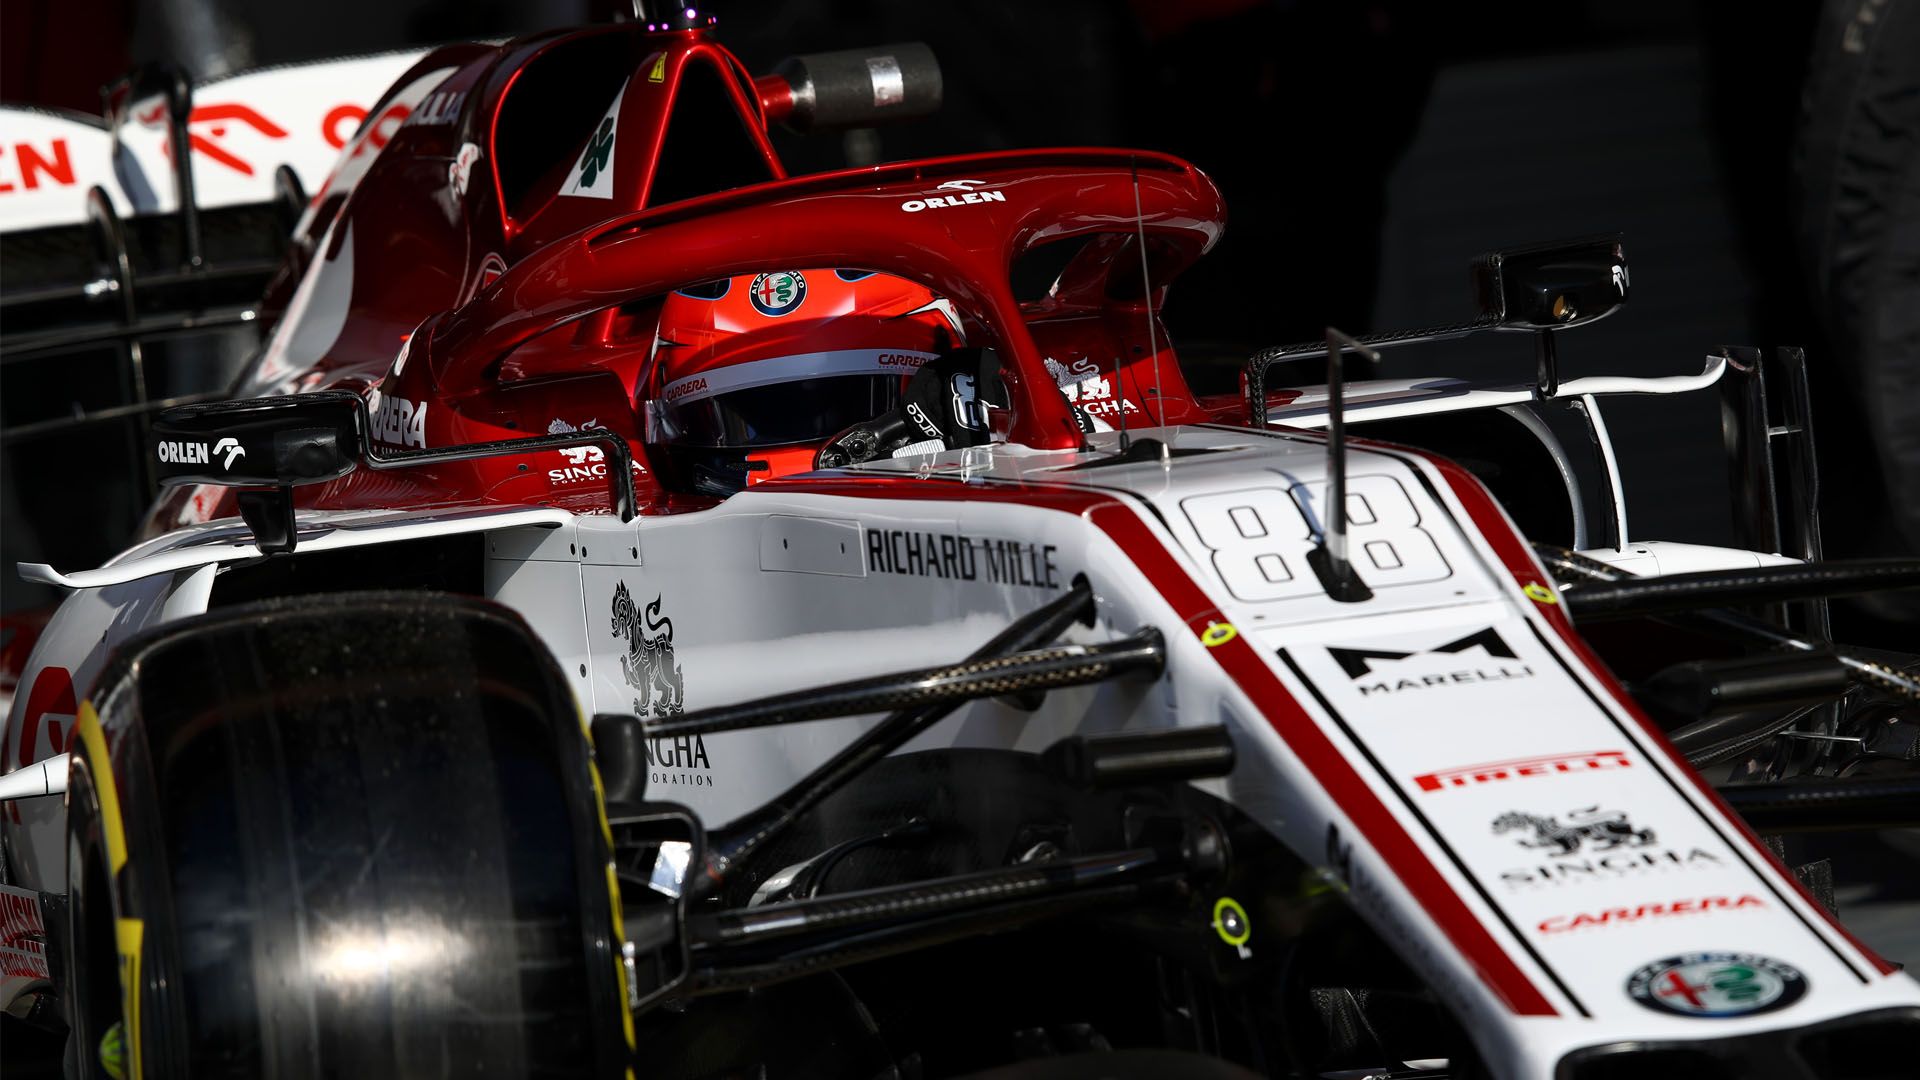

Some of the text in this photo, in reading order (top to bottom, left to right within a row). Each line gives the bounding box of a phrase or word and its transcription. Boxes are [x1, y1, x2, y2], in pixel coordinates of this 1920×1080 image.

[901, 190, 1006, 212] ORLEN
[666, 377, 708, 401] CARRERA
[906, 402, 943, 439] arco
[1077, 398, 1137, 415] GHA
[158, 440, 209, 464] ORLEN
[548, 459, 646, 481] SINGA
[1178, 473, 1454, 603] 88
[867, 528, 1060, 590] RICHARD MILLE
[1357, 665, 1536, 697] MARELLI
[643, 732, 711, 769] NGHA
[652, 772, 713, 787] ORATION
[1413, 750, 1632, 792] PIRELLI
[1499, 846, 1720, 883] SINGHA
[1536, 894, 1769, 935] CARRERA
